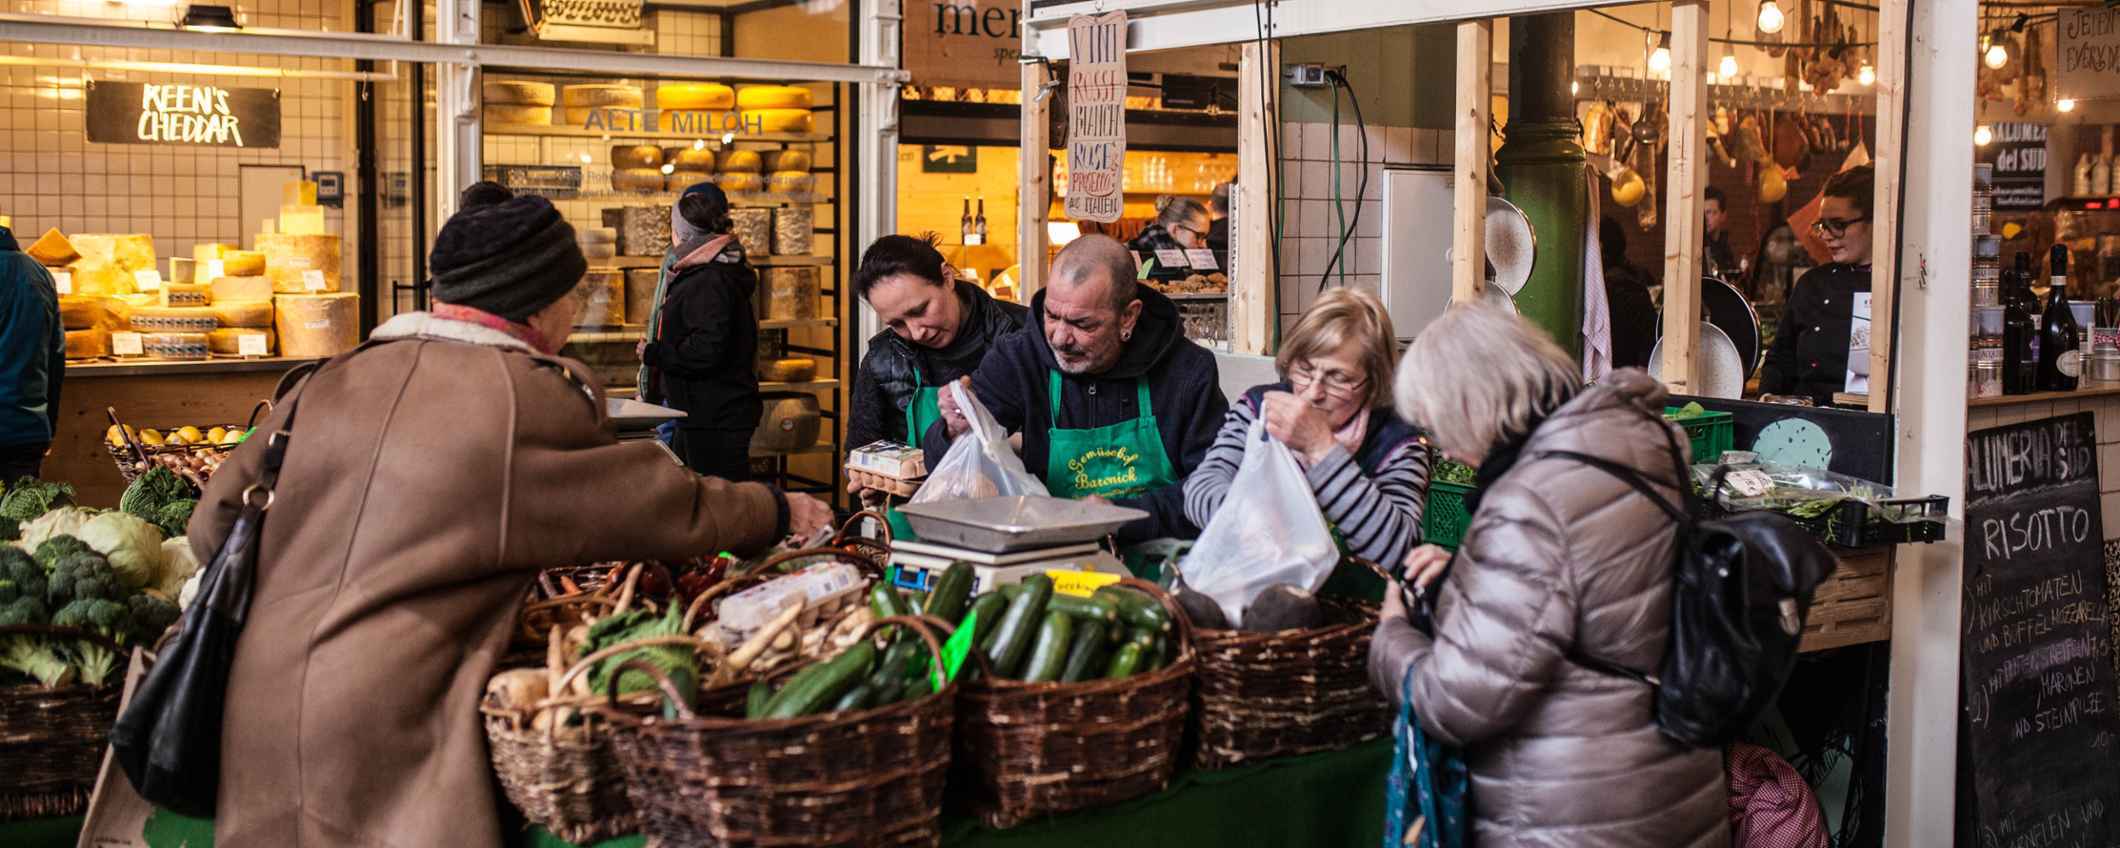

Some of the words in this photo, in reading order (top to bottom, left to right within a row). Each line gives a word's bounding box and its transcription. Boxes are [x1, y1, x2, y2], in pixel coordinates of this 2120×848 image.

[1072, 23, 1118, 64] VINI
[143, 83, 231, 116] KEEN'S
[138, 110, 243, 147] CHEDDAR
[584, 107, 659, 132] ALTE
[1997, 144, 2018, 171] del
[1983, 507, 2089, 560] RISOTTO
